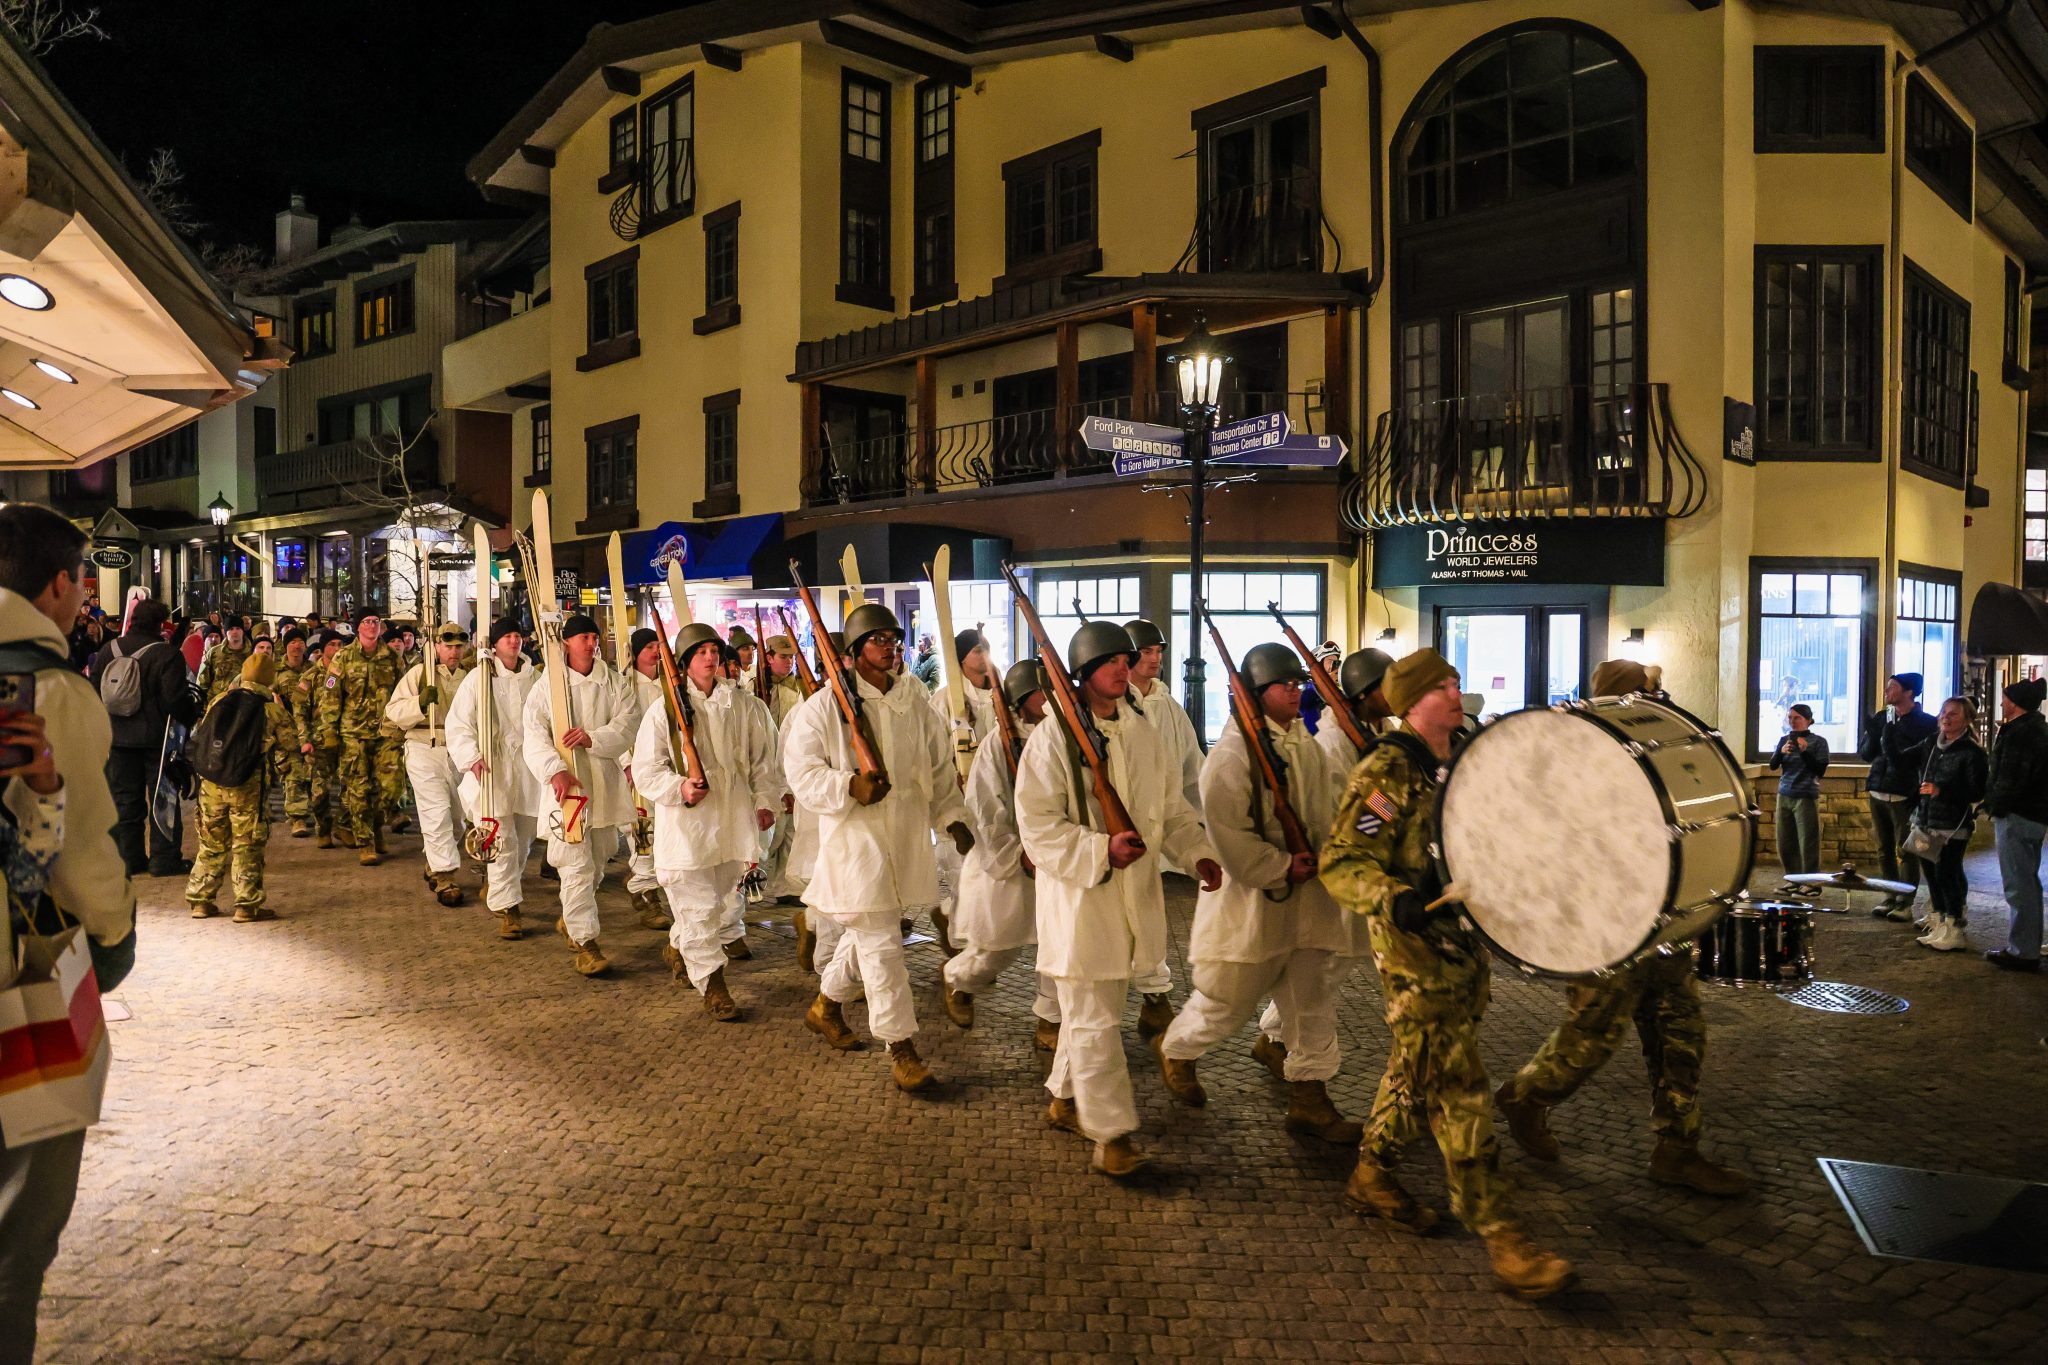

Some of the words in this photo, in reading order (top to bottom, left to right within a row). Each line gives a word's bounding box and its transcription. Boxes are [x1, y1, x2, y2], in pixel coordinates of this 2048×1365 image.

[1094, 419, 1113, 433] Ford
[1115, 422, 1135, 436] Park
[1211, 423, 1256, 442] Transportation
[1257, 419, 1268, 431] Ctr
[1211, 443, 1240, 457] Welcome
[1240, 436, 1263, 450] Center
[1121, 462, 1128, 473] to
[1128, 459, 1142, 471] Gore
[1142, 456, 1160, 469] Valley
[1426, 528, 1538, 561] Princess
[1446, 556, 1481, 567] WORLD
[1482, 555, 1538, 566] JEWELERS
[1431, 571, 1457, 579] ALASKA
[1511, 569, 1528, 577] VAIL
